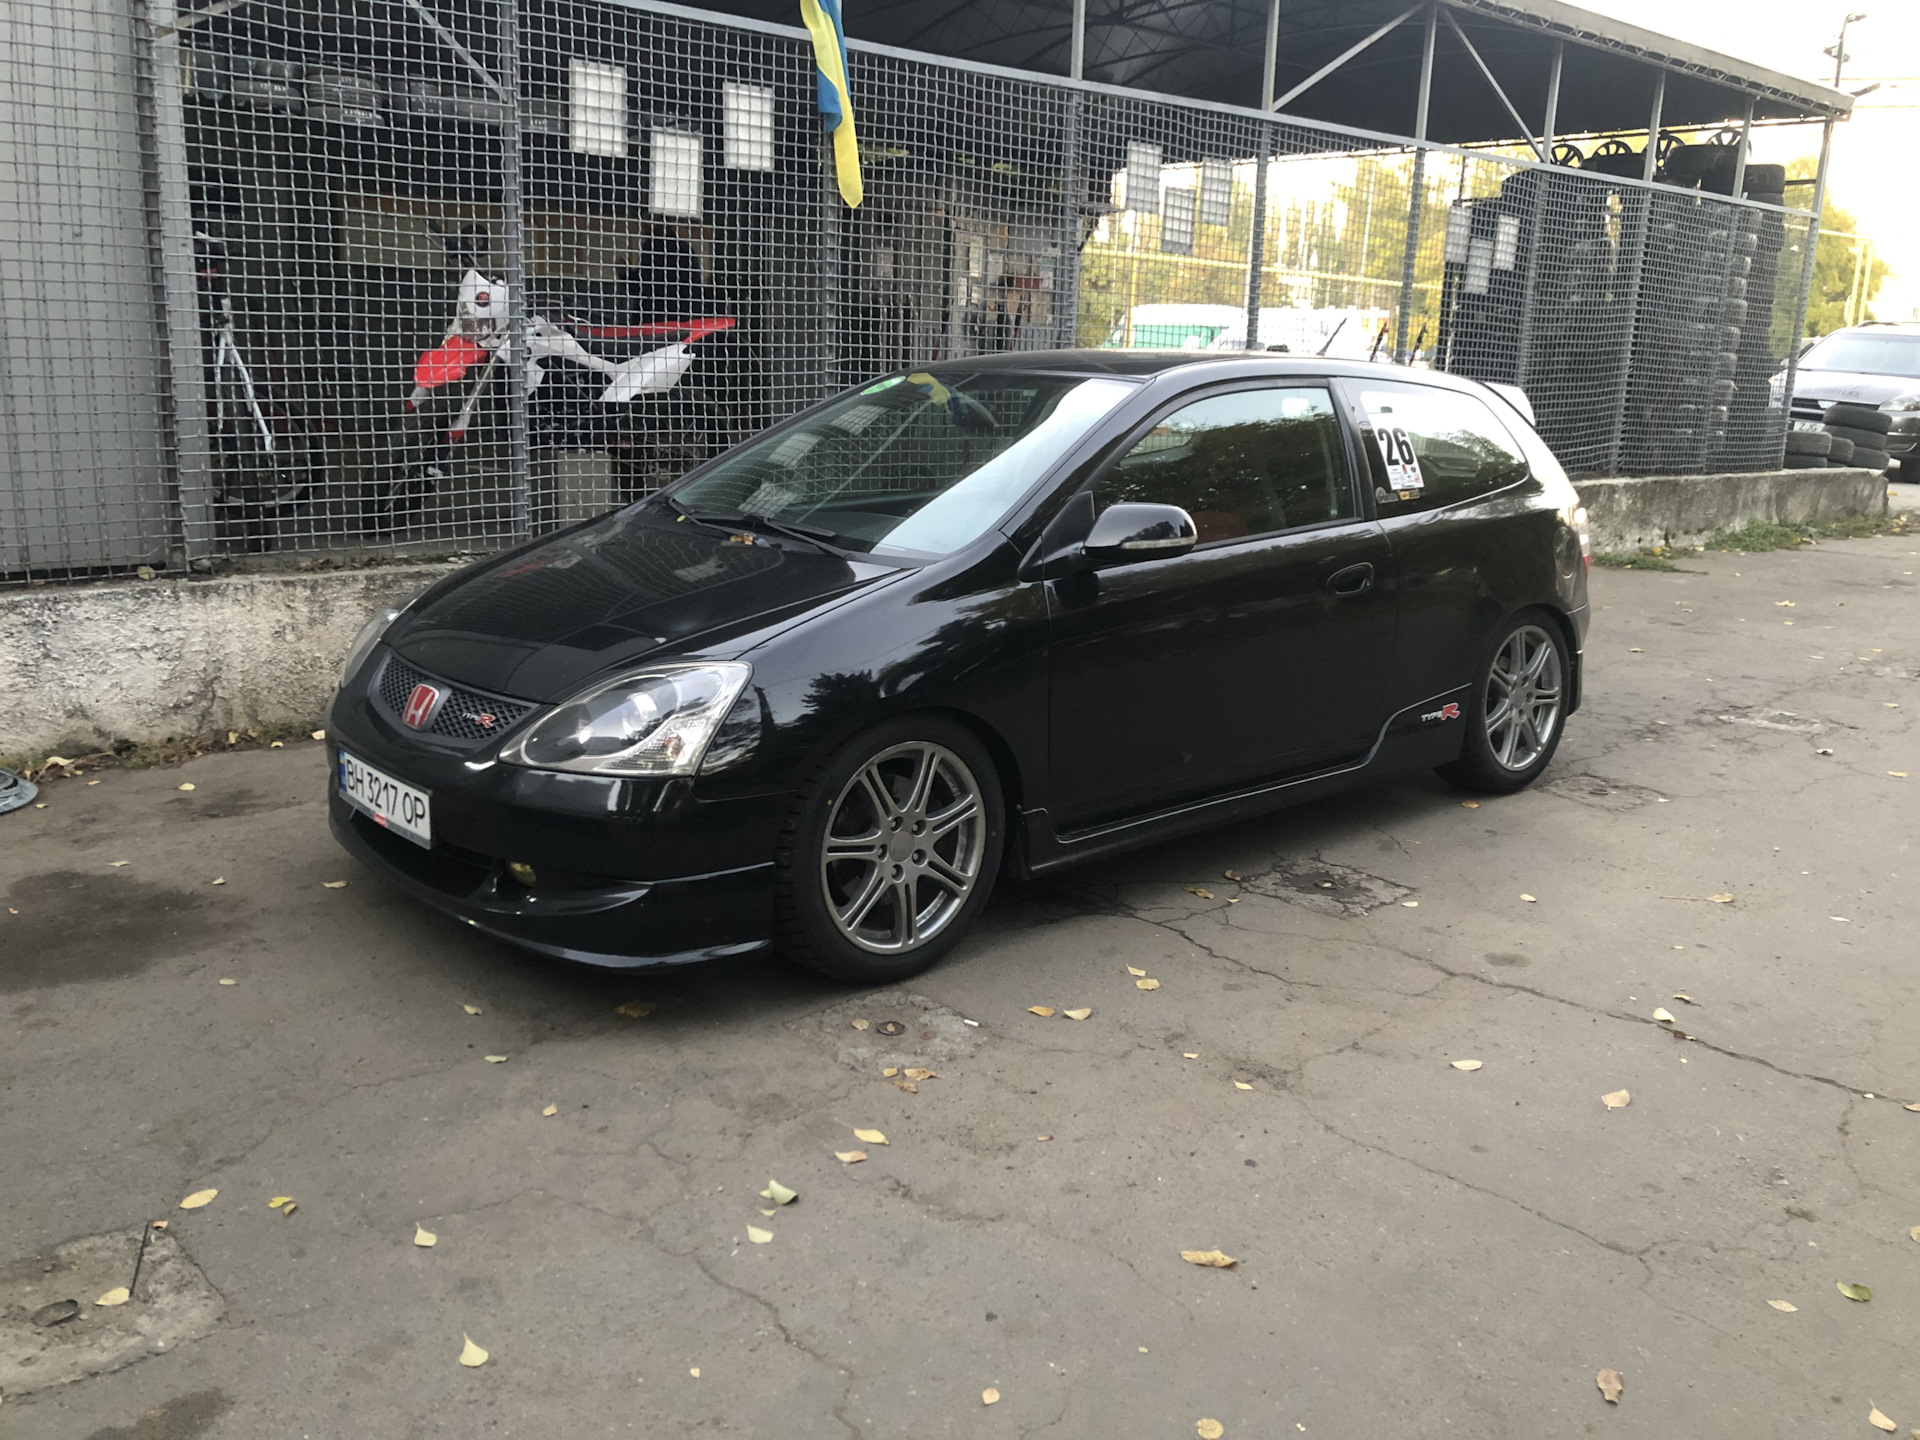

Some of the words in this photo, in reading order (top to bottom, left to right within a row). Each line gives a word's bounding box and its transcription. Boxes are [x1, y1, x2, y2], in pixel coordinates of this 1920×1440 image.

[1378, 427, 1414, 466] 26
[1441, 702, 1461, 721] R
[346, 758, 365, 799] BH
[366, 771, 398, 816] 3217
[402, 791, 426, 829] OP
